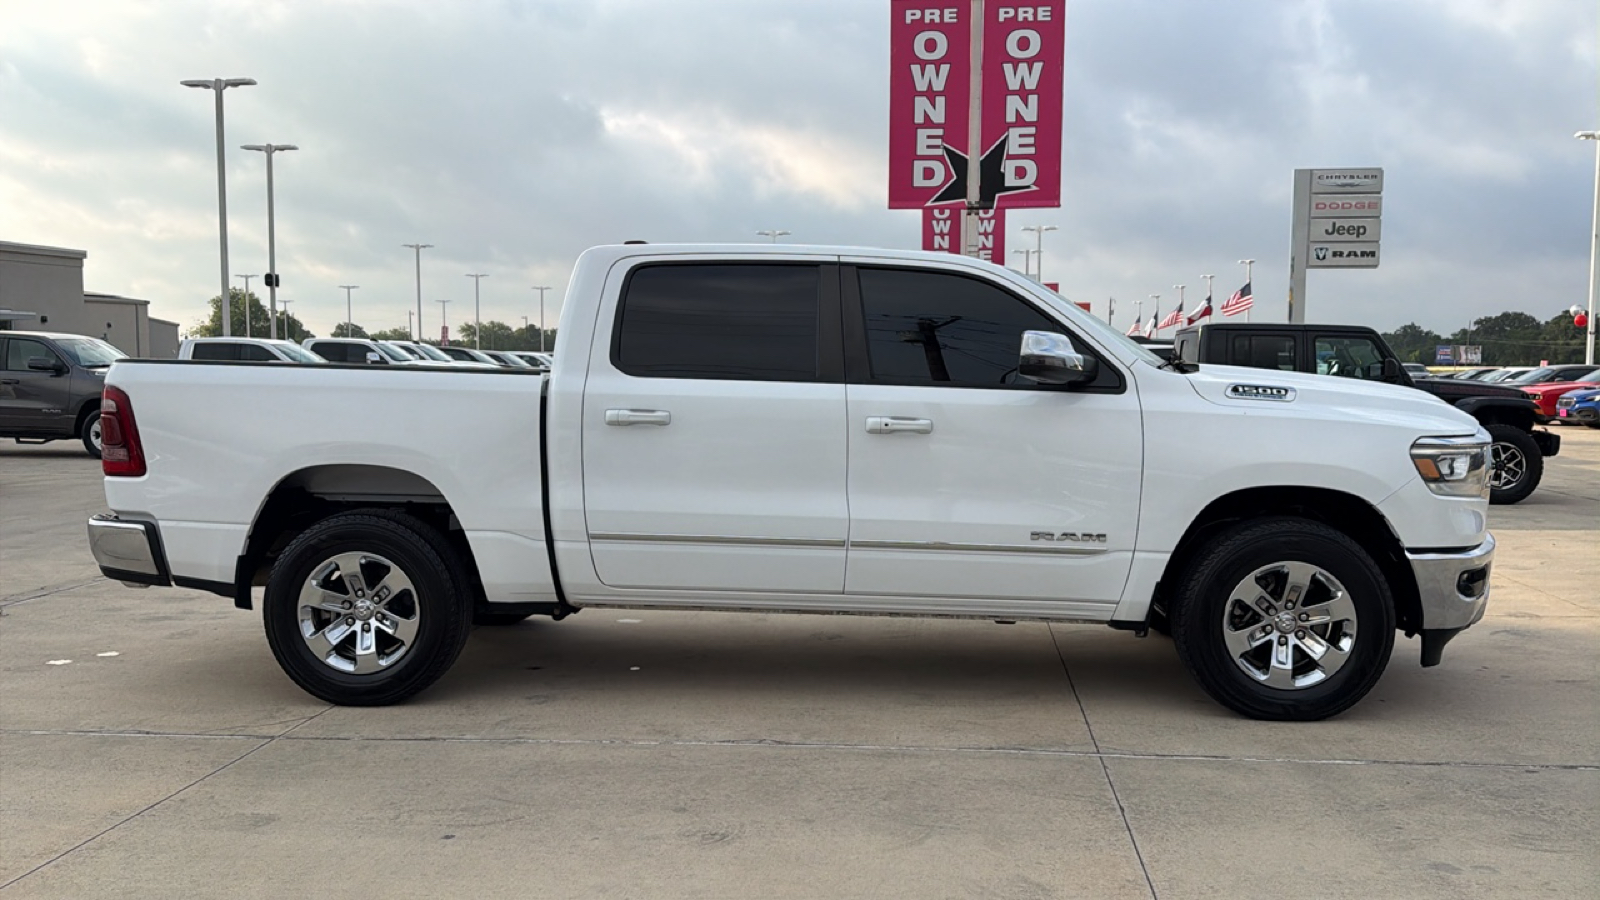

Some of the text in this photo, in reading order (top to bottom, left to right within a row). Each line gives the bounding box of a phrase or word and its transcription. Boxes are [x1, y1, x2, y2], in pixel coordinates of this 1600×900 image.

[905, 8, 958, 24] PRE
[998, 6, 1052, 22] PRE
[910, 30, 951, 188] OWNED
[1002, 28, 1044, 188] OWNED
[1315, 201, 1379, 210] DODGE
[931, 208, 951, 252] OWN
[1324, 221, 1367, 238] Jeep
[1331, 250, 1376, 258] RAM
[1231, 384, 1289, 396] 1500
[1030, 531, 1107, 543] RAM
